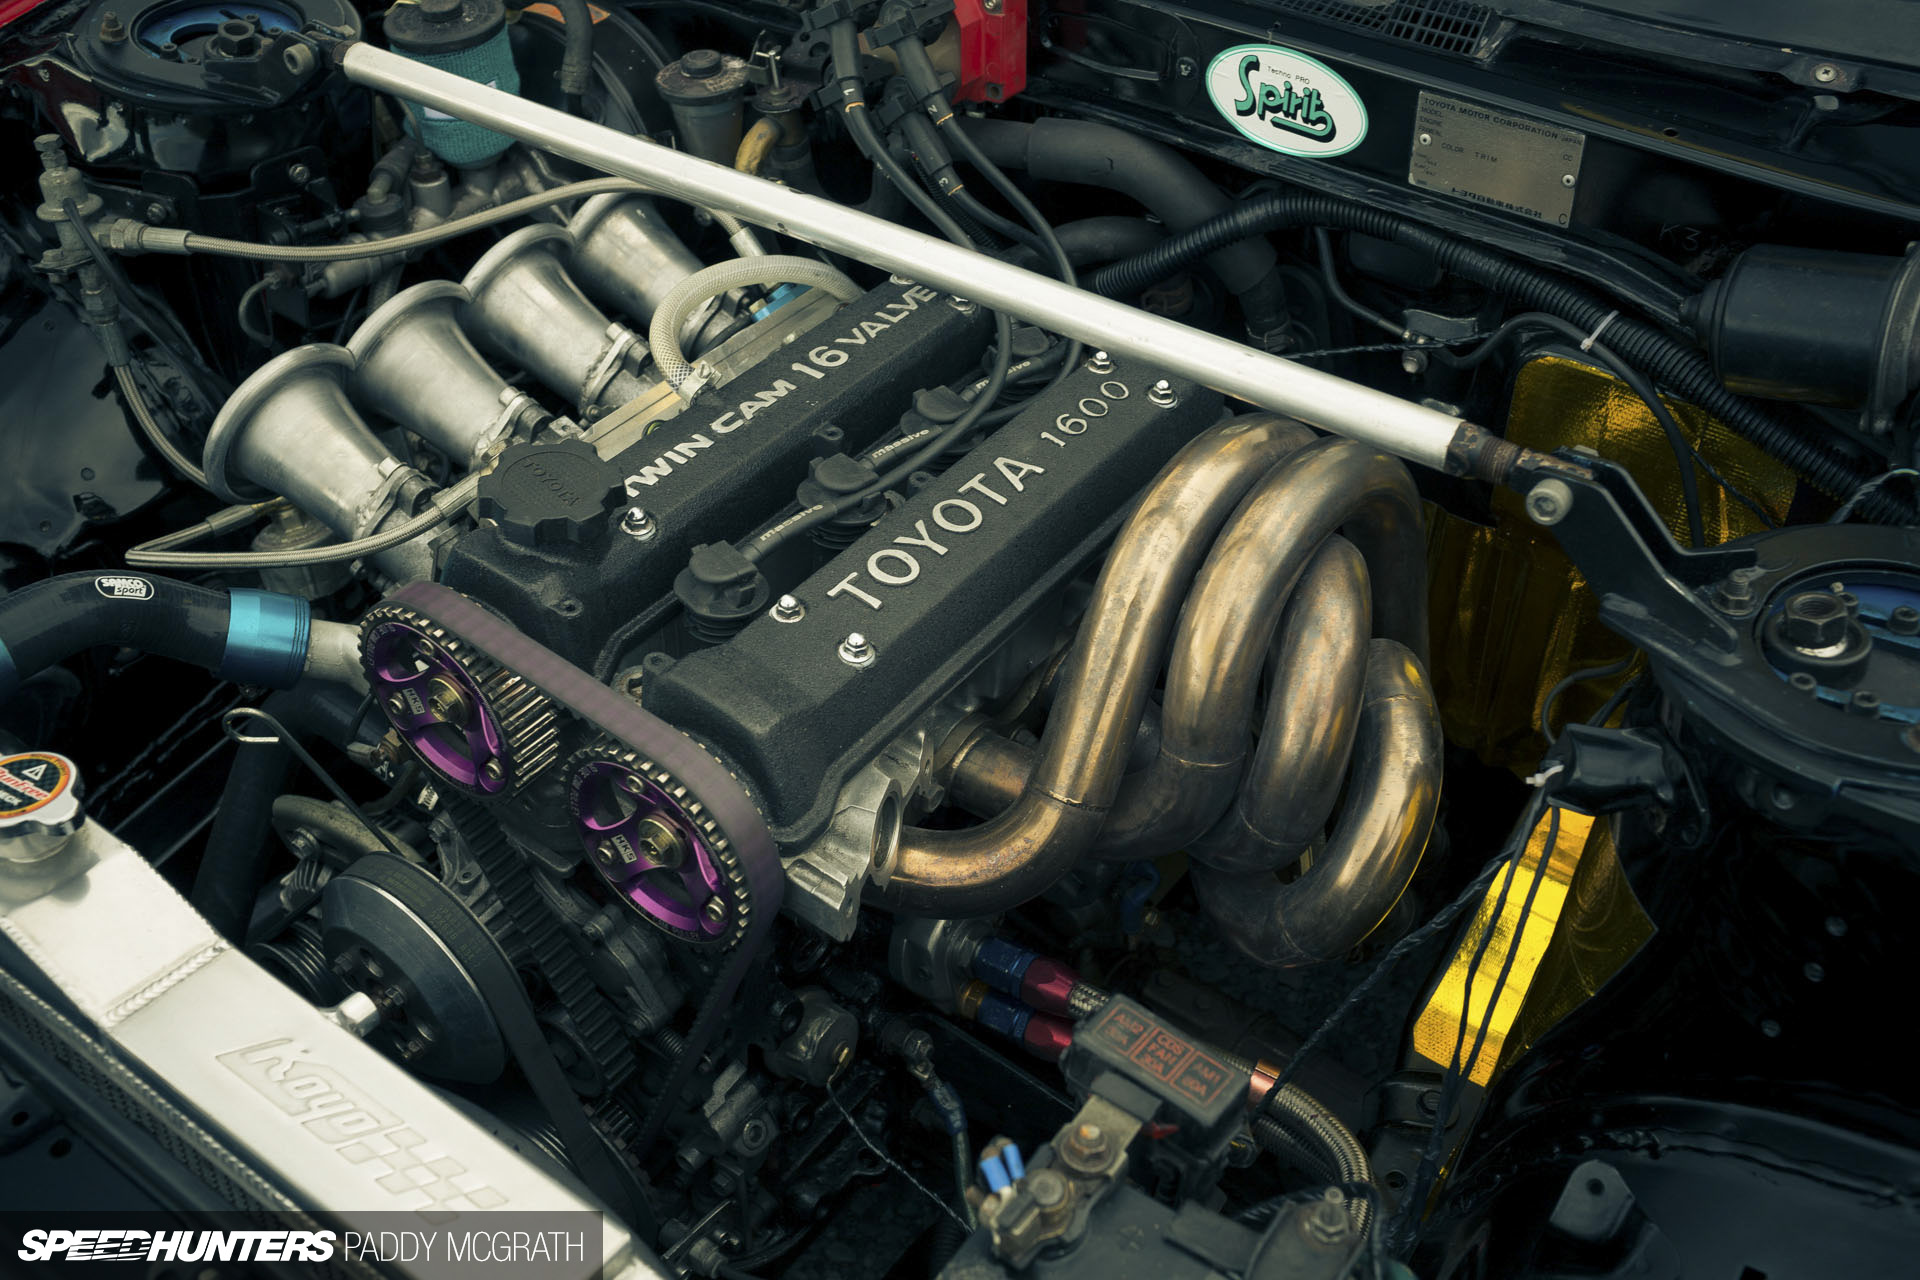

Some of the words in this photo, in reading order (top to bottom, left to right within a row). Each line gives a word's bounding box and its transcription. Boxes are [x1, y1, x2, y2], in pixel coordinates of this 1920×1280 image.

[1267, 65, 1291, 79] Techno
[1295, 74, 1311, 85] PRO
[1234, 54, 1337, 143] Spirit
[1424, 98, 1456, 112] TOYOTA
[1459, 108, 1490, 122] MOTOR
[1493, 116, 1558, 140] CORPORATION
[1441, 142, 1464, 153] COLOR
[1475, 151, 1498, 163] TRIM
[709, 379, 798, 434] CAM
[791, 345, 849, 380] 16
[835, 285, 938, 346] VALVE
[871, 429, 931, 459] massive
[523, 460, 581, 507] TOYOTA
[826, 456, 1045, 611] TOYOTA
[1040, 381, 1130, 448] 1600
[759, 504, 825, 542] massive
[116, 587, 143, 596] sport
[404, 688, 424, 713] HKS
[613, 834, 635, 862] HKS
[238, 1037, 386, 1138] Koyo
